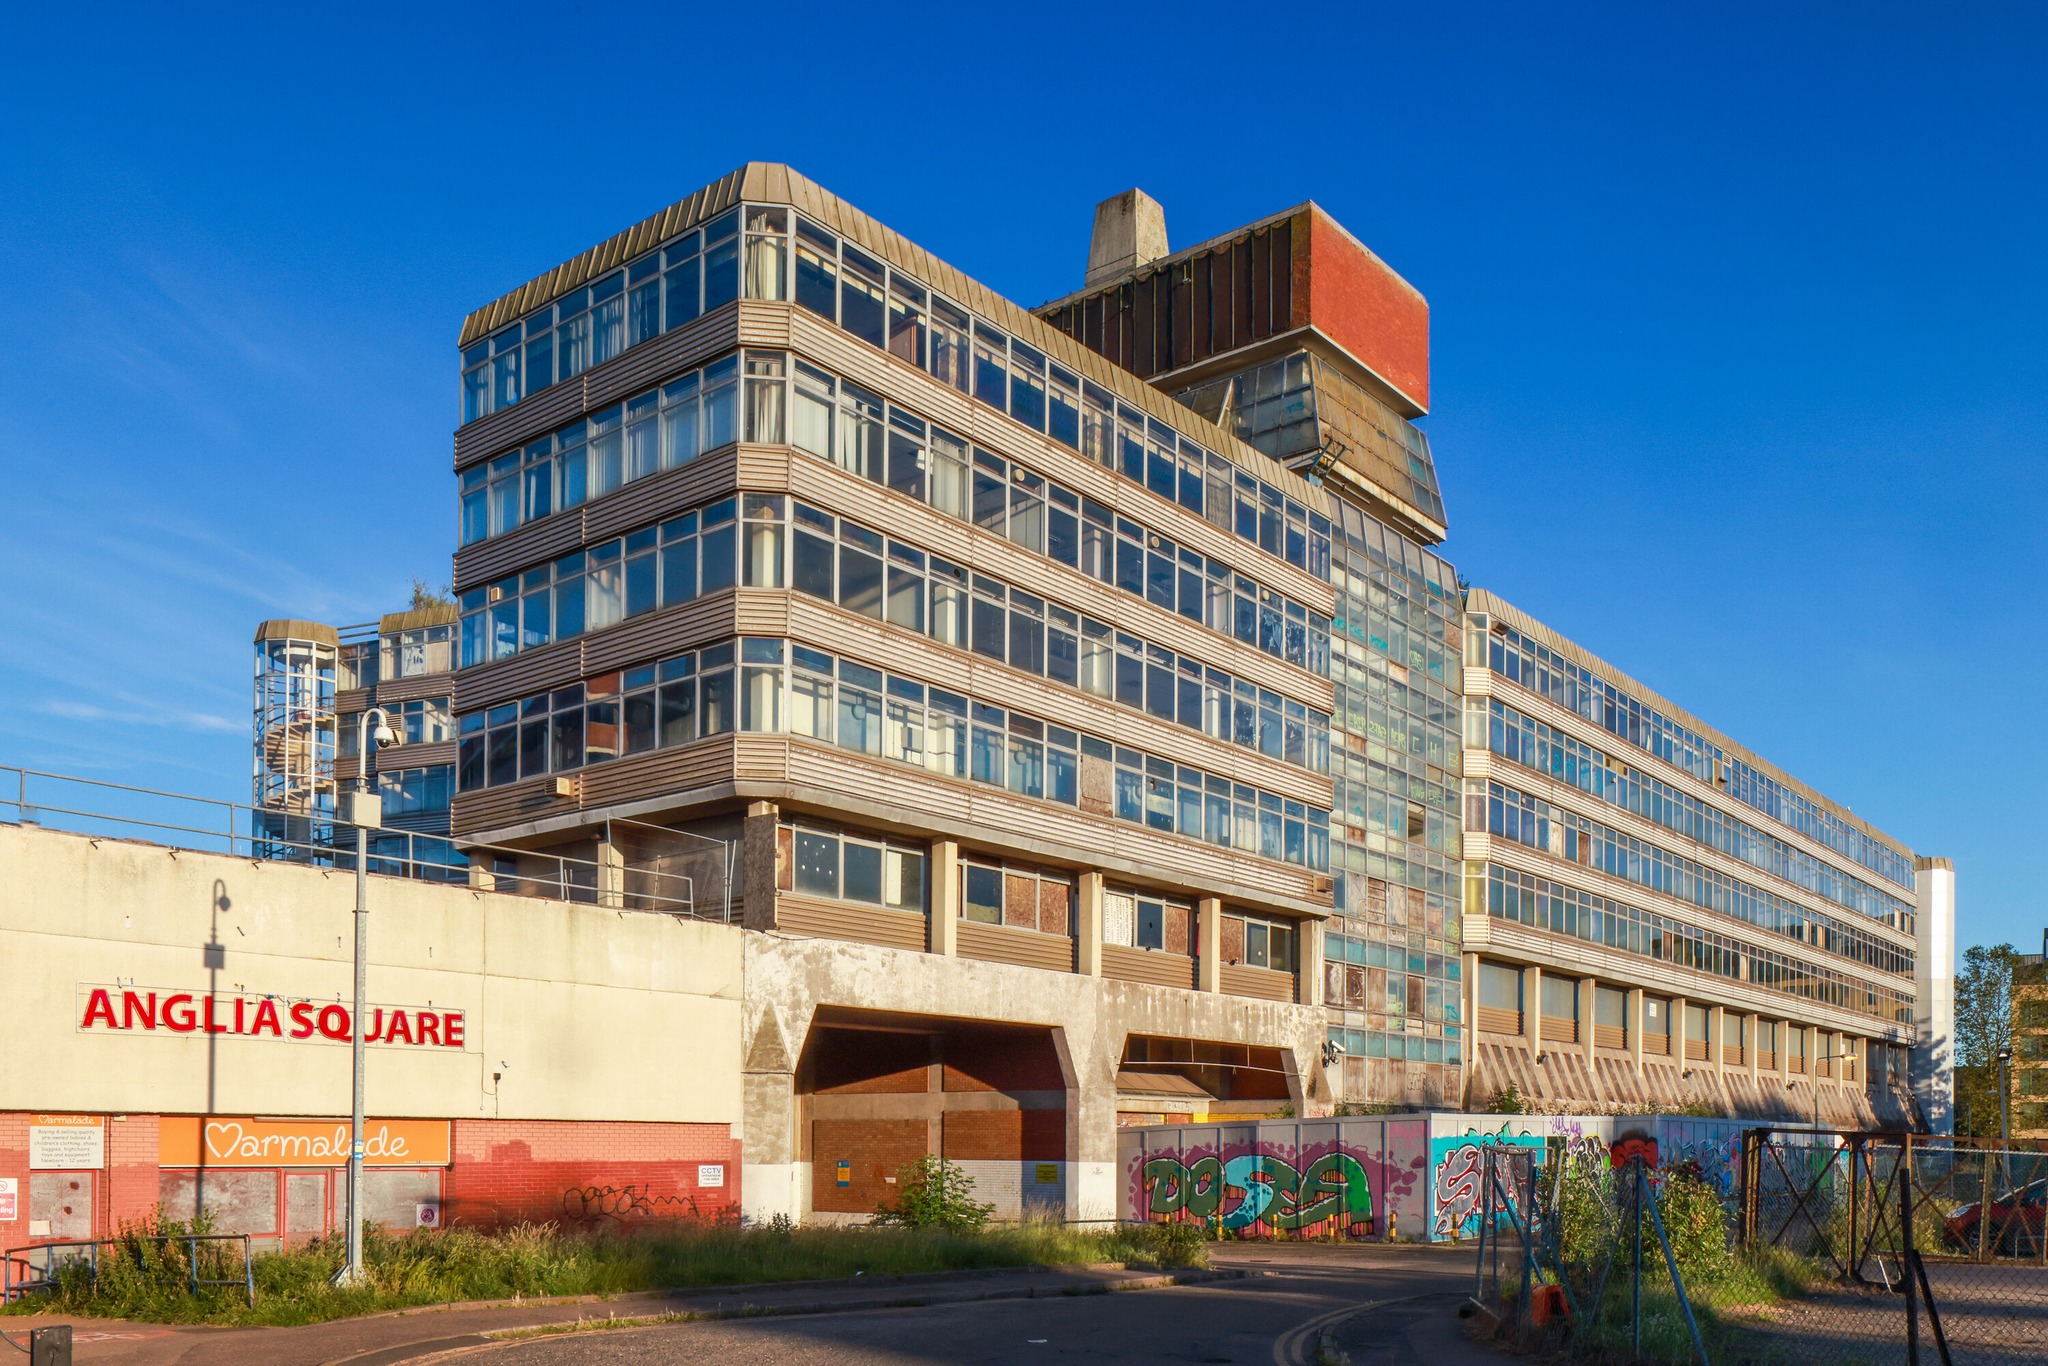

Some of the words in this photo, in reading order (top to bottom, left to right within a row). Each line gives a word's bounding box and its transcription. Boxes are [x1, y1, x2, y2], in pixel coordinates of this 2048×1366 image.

[82, 988, 282, 1037] ANGLIA
[289, 1002, 464, 1047] SQUARE
[204, 1122, 409, 1158] Marmalde
